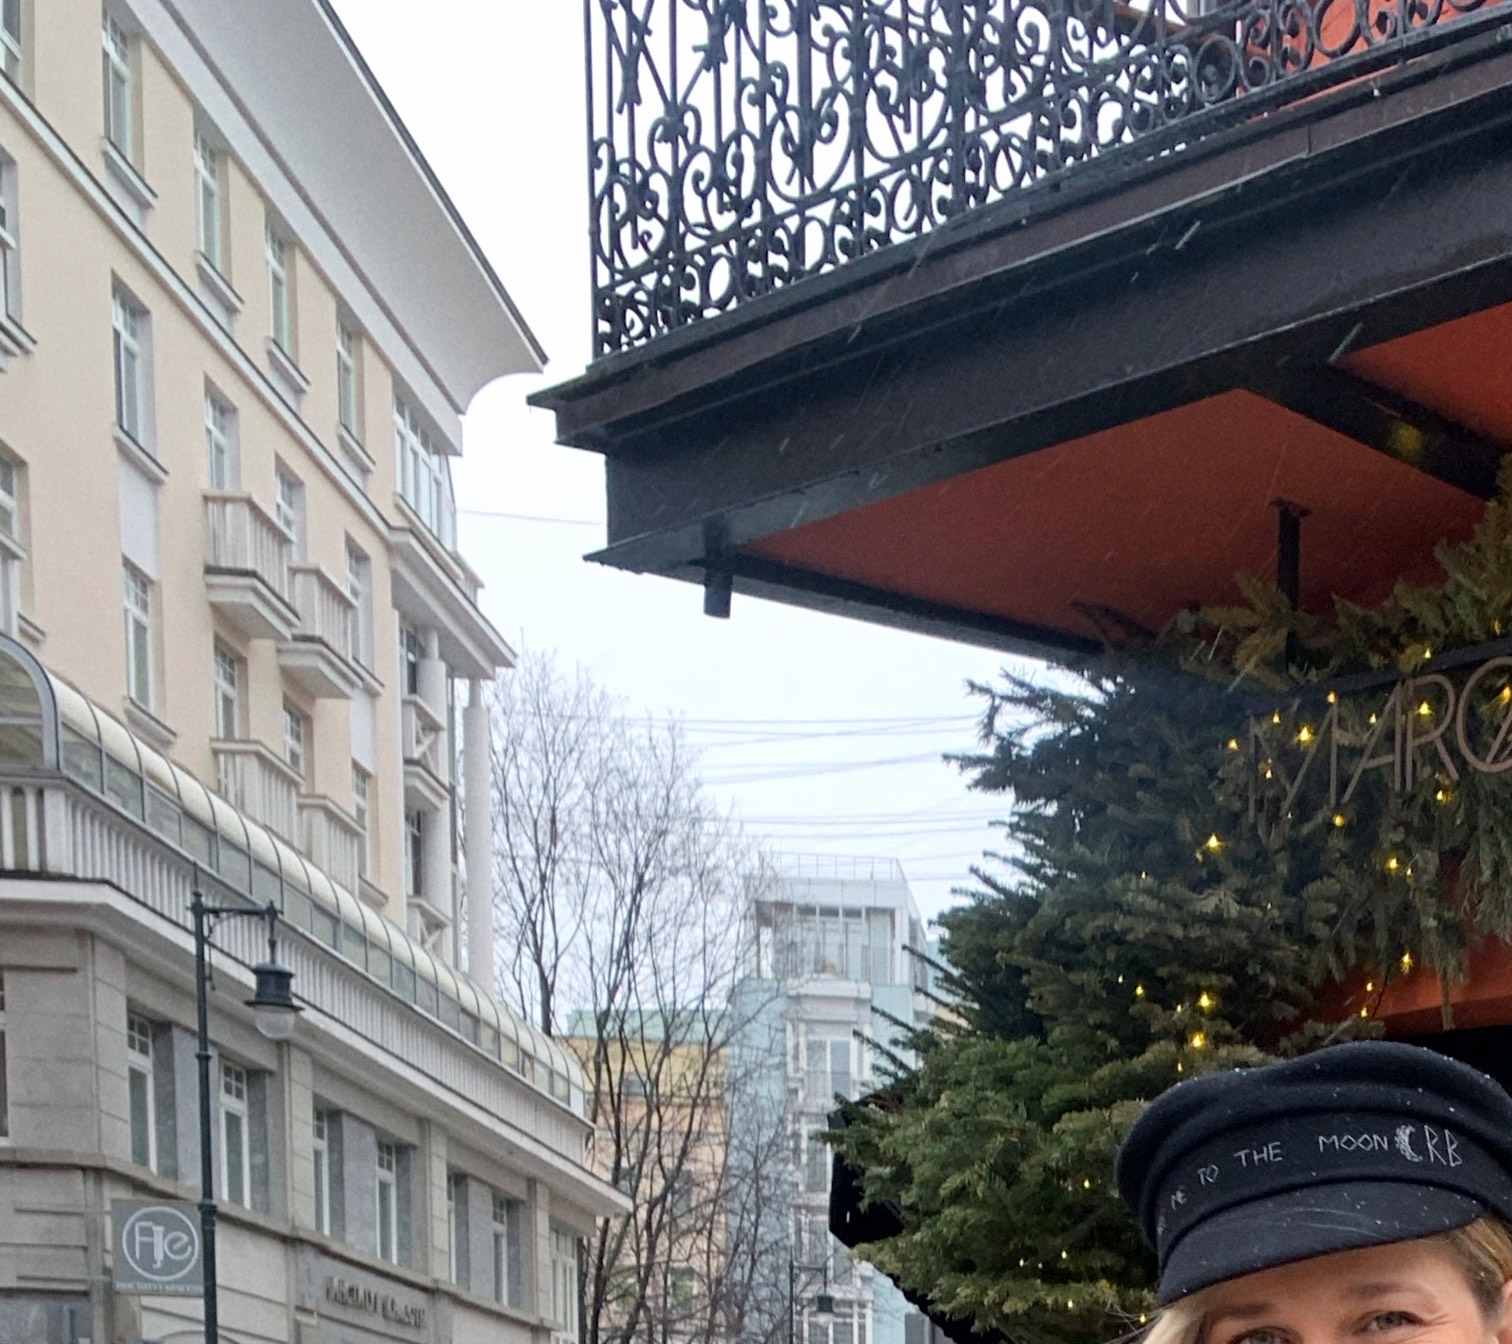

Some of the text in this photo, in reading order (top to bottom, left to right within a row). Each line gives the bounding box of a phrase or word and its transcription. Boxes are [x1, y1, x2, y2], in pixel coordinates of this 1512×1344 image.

[1196, 1163, 1220, 1187] TO
[1233, 1141, 1284, 1168] THE
[1317, 1133, 1390, 1154] MOON
